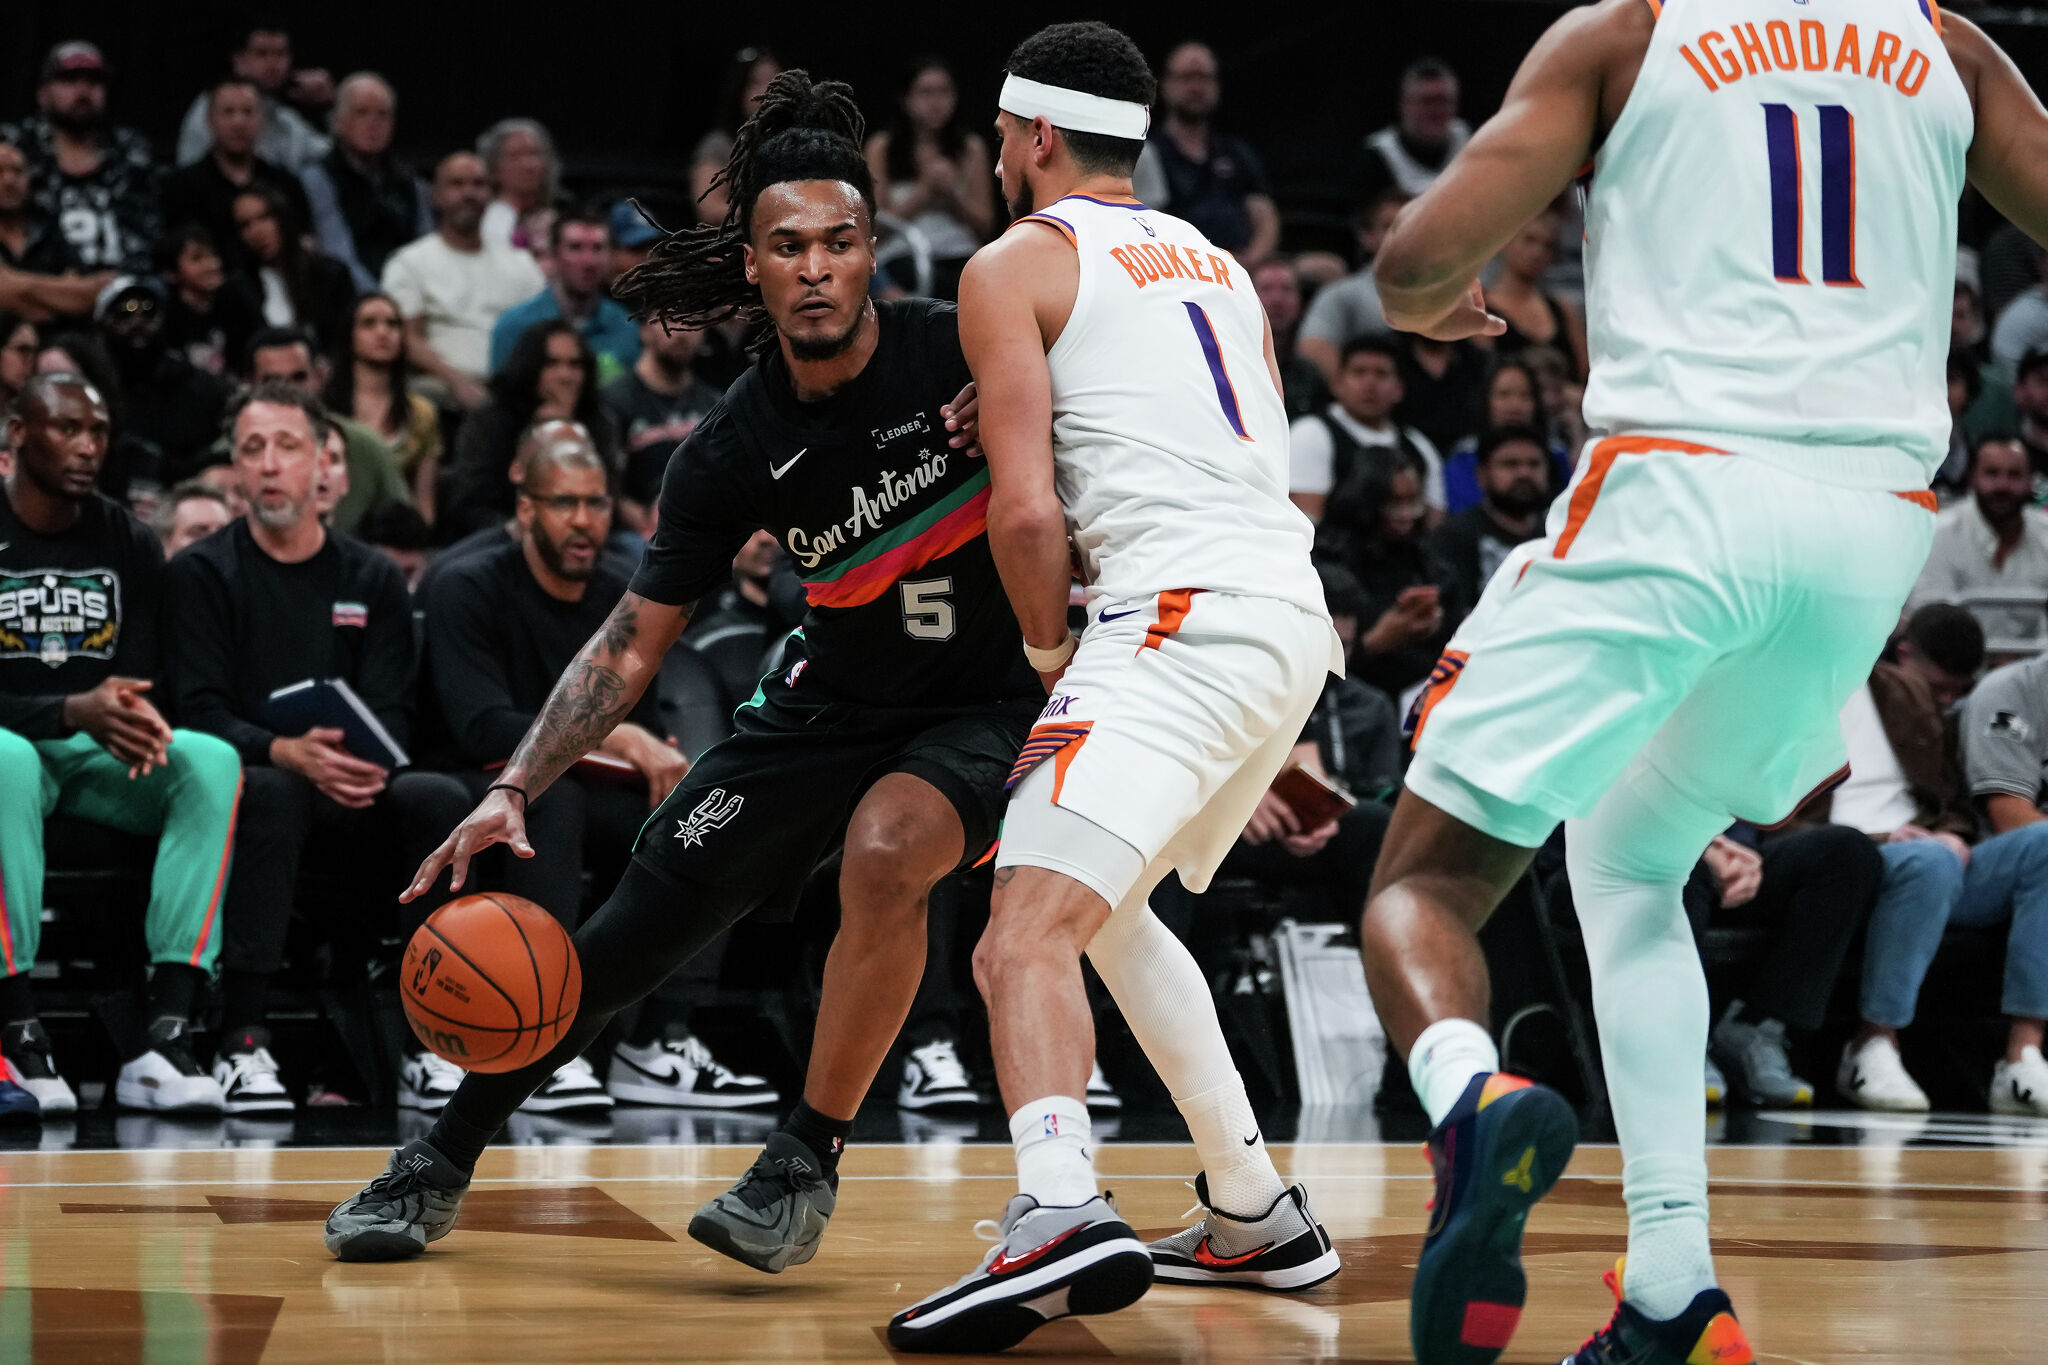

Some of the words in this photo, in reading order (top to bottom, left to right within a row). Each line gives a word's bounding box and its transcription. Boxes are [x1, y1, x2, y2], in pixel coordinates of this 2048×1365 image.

[1678, 18, 1931, 97] IGHODARO
[1759, 102, 1867, 289] 11
[1109, 241, 1234, 291] BOOKER
[1181, 300, 1256, 442] 1
[880, 420, 922, 443] LEDGER
[787, 524, 847, 569] San
[844, 448, 949, 538] Antonio
[0, 586, 108, 620] SPURS
[899, 575, 957, 642] 5
